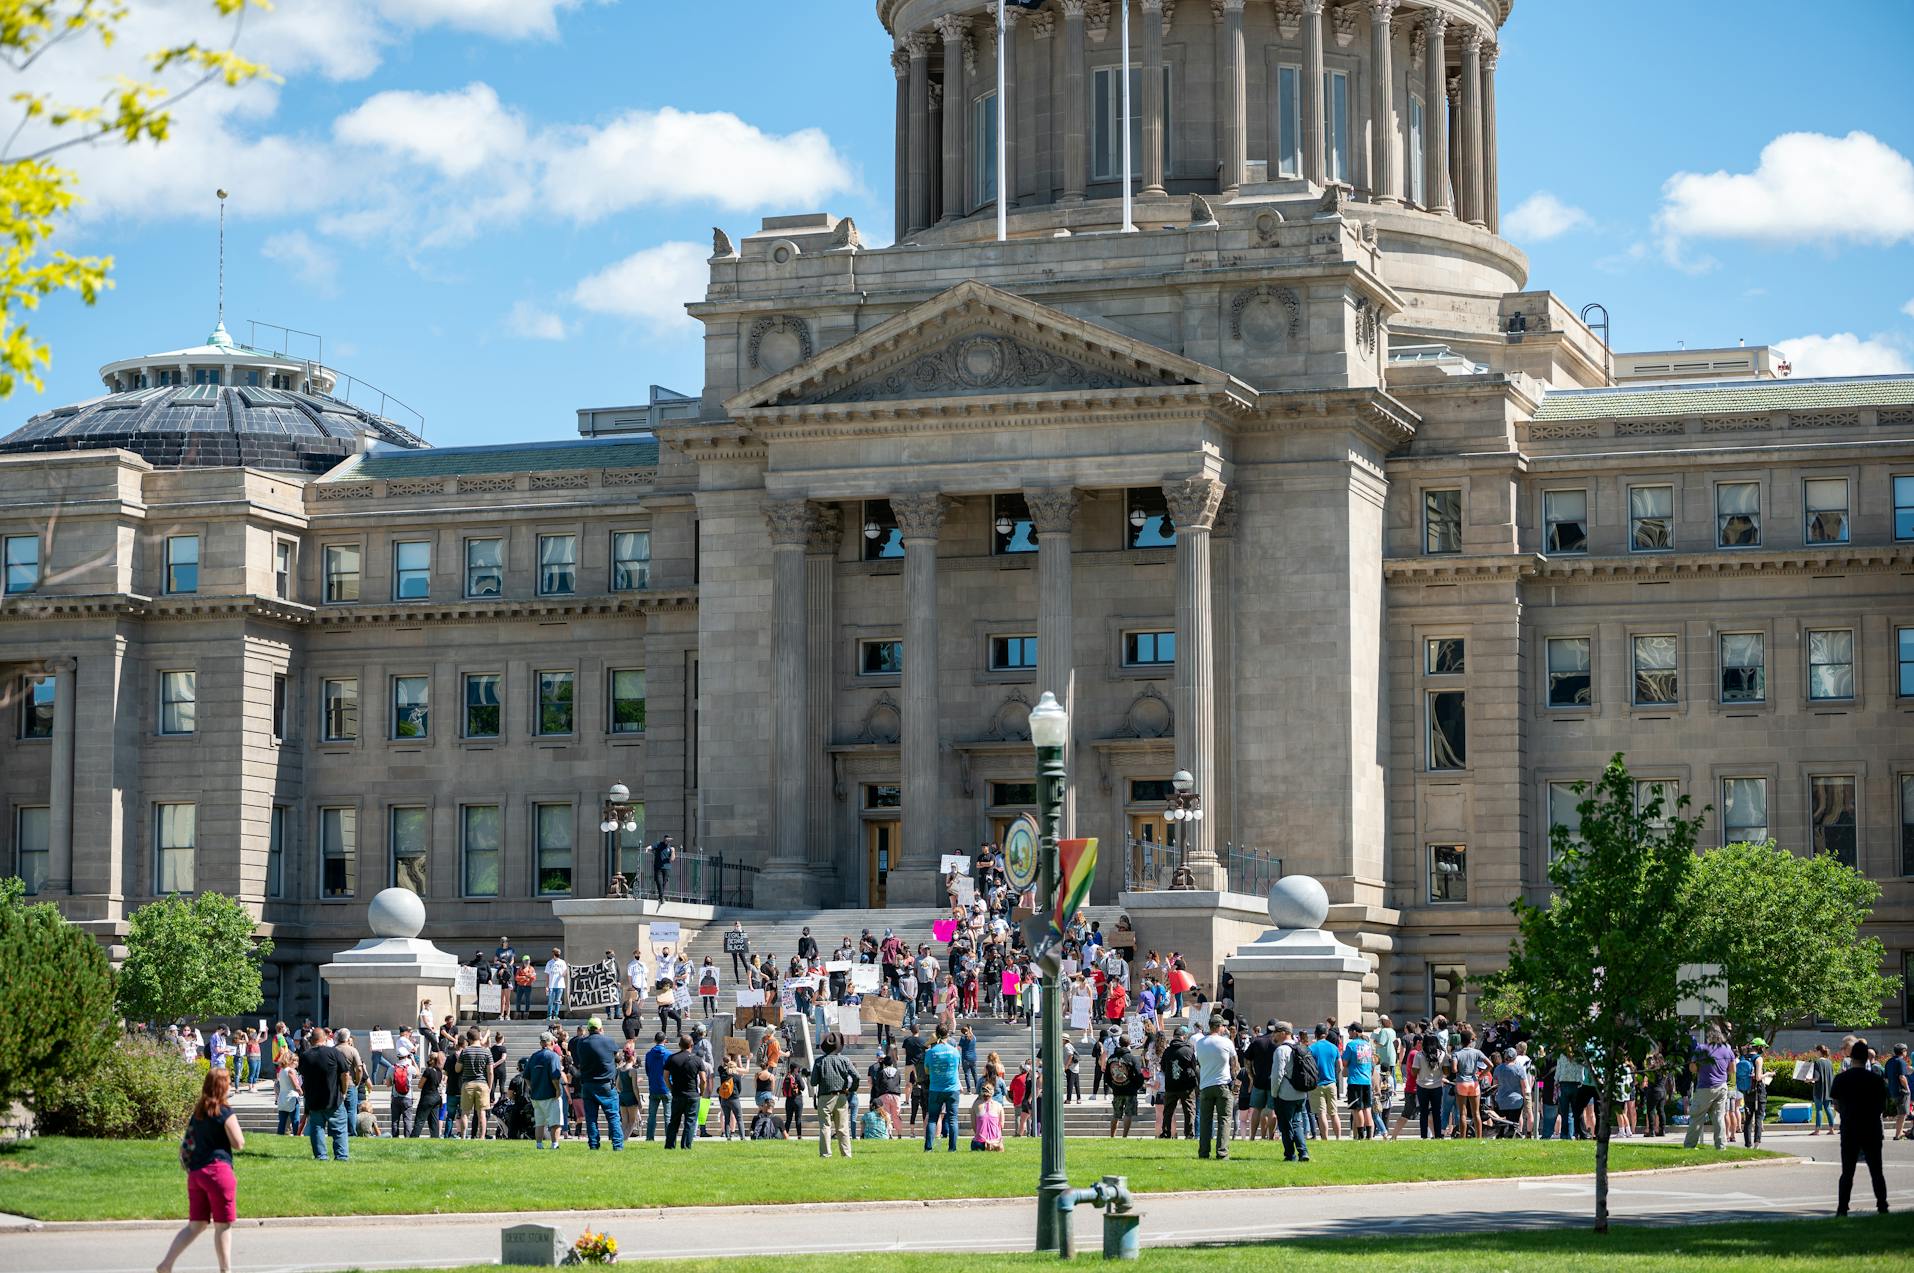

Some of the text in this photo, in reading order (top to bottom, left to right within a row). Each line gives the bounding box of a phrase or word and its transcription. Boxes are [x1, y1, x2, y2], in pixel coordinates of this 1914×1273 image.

[726, 943, 745, 951] BLACK
[570, 959, 612, 978] BLACK
[573, 971, 617, 992] LIVES
[570, 986, 619, 1006] MATTER
